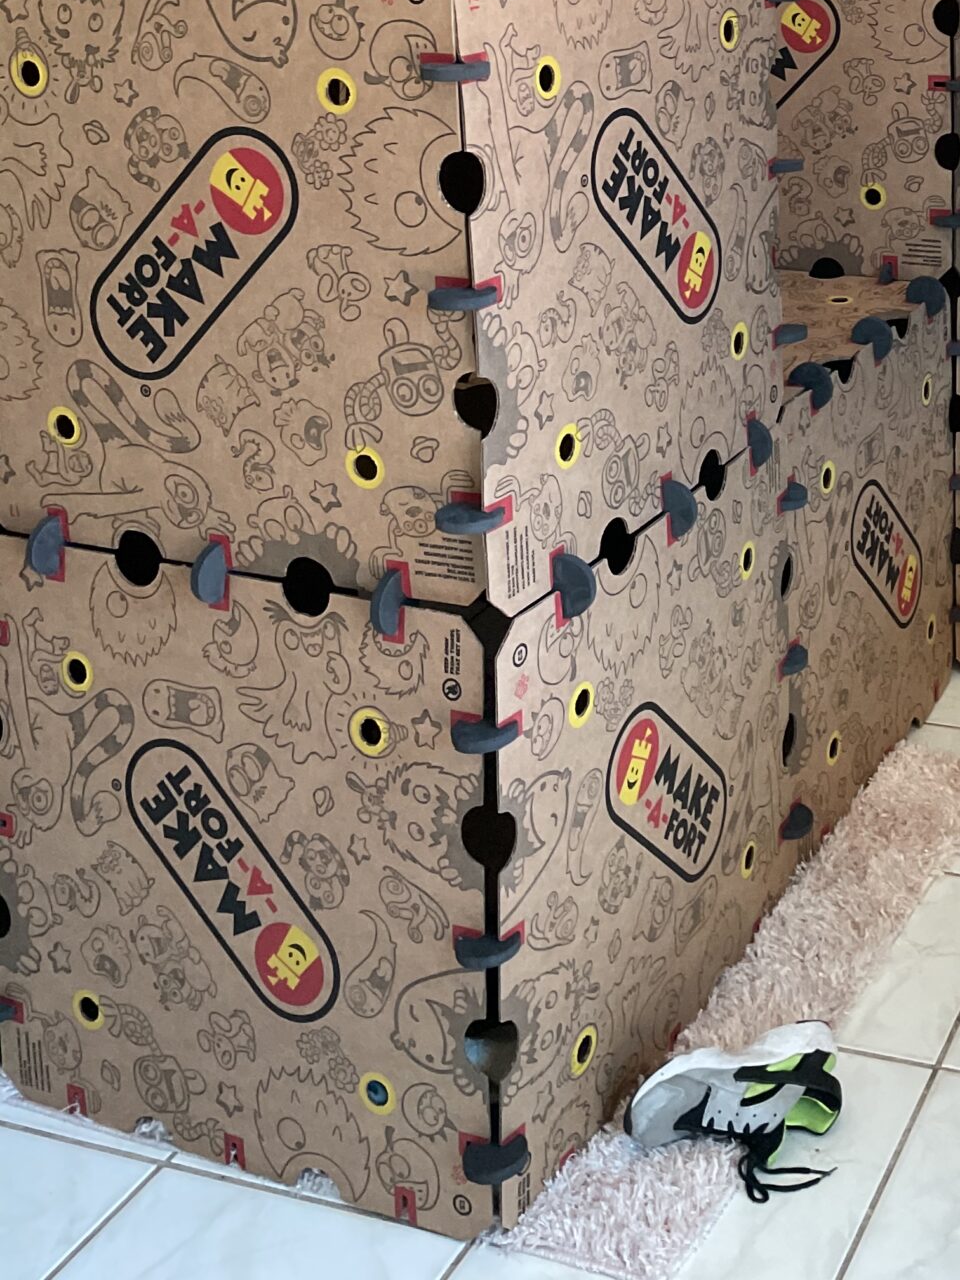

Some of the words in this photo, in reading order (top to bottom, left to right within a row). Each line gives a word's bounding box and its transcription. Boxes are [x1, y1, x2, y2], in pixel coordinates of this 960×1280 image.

[602, 153, 681, 273] MAKE
[126, 221, 240, 364] MAKE
[856, 517, 900, 595] MAKE
[654, 744, 721, 832] MAKE
[140, 780, 262, 936] MAKE
